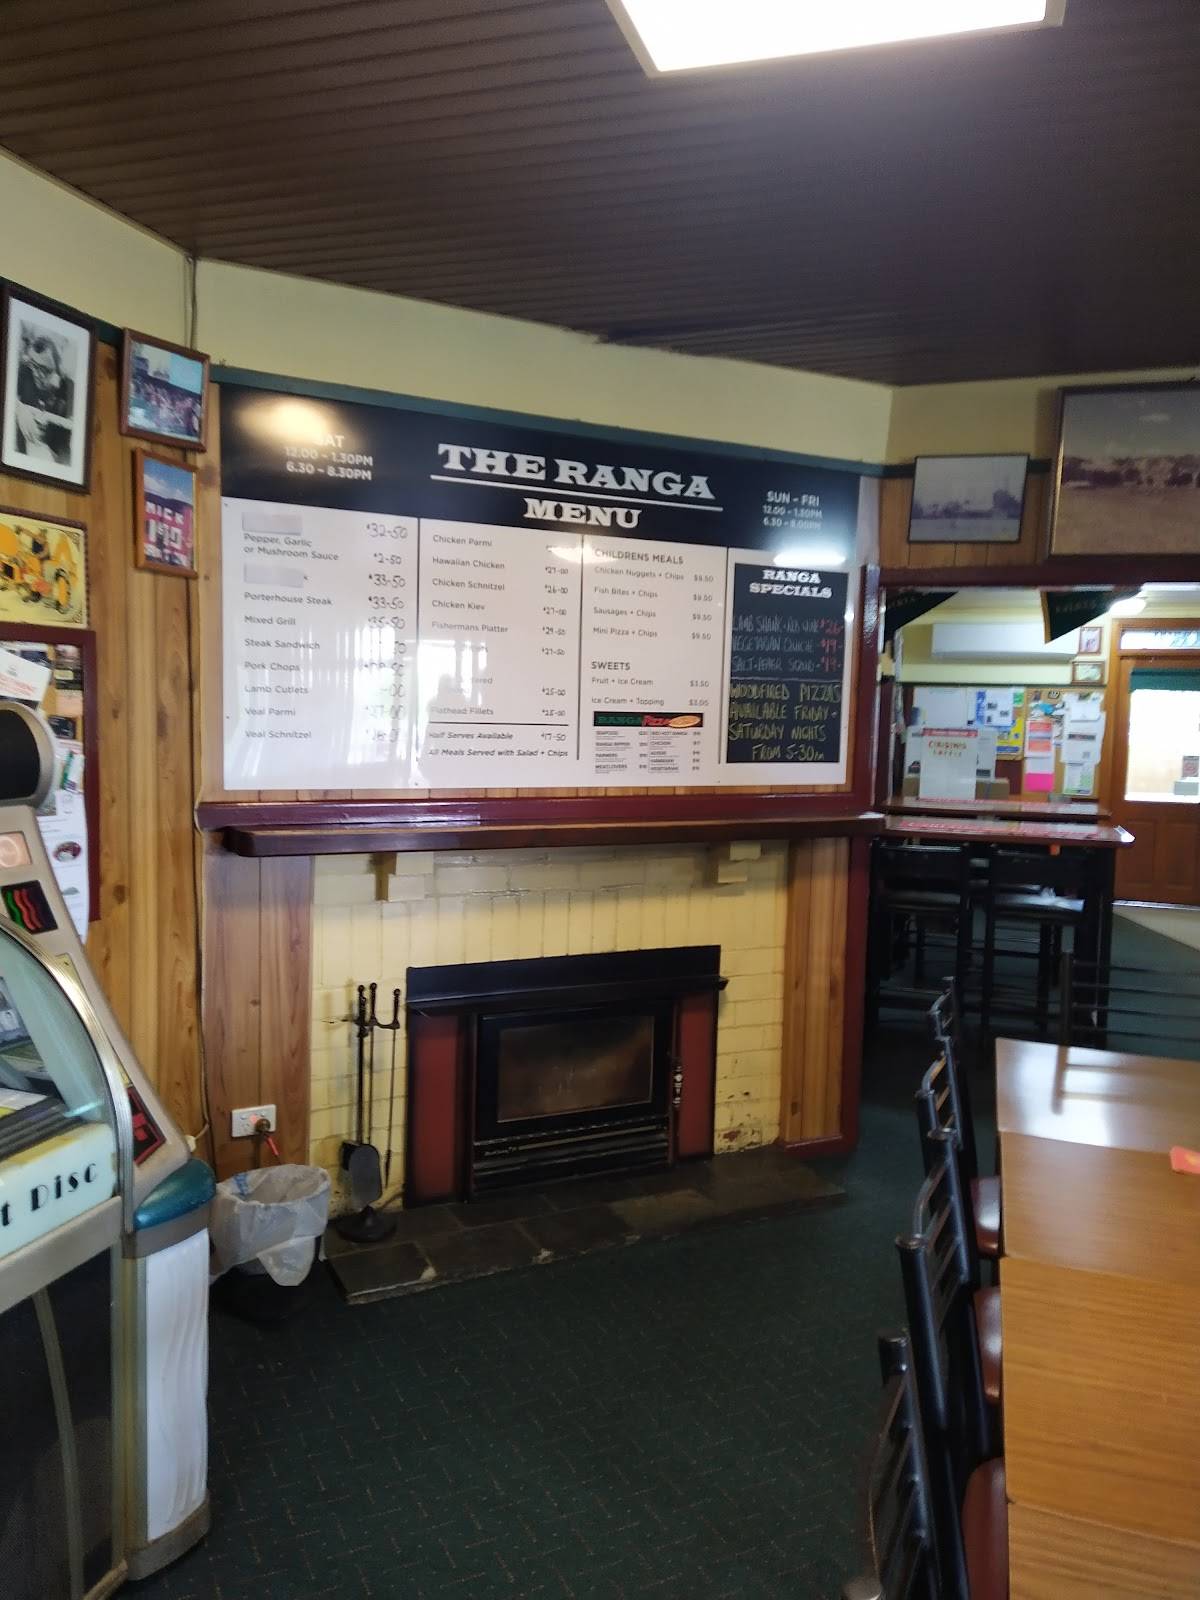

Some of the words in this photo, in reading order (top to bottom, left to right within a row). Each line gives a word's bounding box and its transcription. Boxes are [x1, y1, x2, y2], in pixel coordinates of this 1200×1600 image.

[332, 452, 373, 466] 1.30PM
[286, 461, 315, 475] 6.30
[327, 466, 372, 481] 8.30PM
[438, 443, 546, 481] THE
[554, 459, 716, 500] RANGA
[767, 490, 790, 504] SUN
[801, 494, 820, 506] FRI
[523, 497, 642, 529] MENU
[284, 537, 312, 547] Garlic
[432, 535, 466, 545] Chicken
[468, 538, 493, 547] Parmi
[257, 546, 308, 558] Mushroom
[311, 551, 339, 561] Sauce
[595, 549, 649, 561] CHILDRENS
[652, 555, 684, 564] MEALS
[432, 557, 471, 567] Hawaiian
[473, 560, 505, 569] Chicken
[594, 566, 624, 575] Chicken
[626, 569, 656, 578] Nuggets
[665, 572, 684, 580] Chips
[763, 569, 821, 584] RANGA
[432, 578, 466, 588] Chicken
[468, 581, 505, 591] Schnitzel
[749, 582, 832, 599] SPECIALS
[594, 586, 609, 594] Fish
[638, 589, 658, 598] Chips
[244, 592, 303, 604] Porterhouse
[306, 596, 333, 605] Steak
[432, 600, 465, 610] Chicken
[467, 602, 485, 610] Kiev
[593, 607, 628, 616] Sausages
[636, 609, 656, 618] Chips
[244, 615, 273, 624] Mixed
[276, 617, 296, 625] Grill
[432, 621, 479, 632] Fishermans
[481, 623, 508, 633] Platter
[593, 627, 608, 635] Mini
[610, 627, 629, 636] Pizza
[638, 629, 658, 638] Chips
[244, 639, 272, 648] Steak
[274, 640, 320, 650] Sandwich
[244, 661, 266, 670] Pork
[270, 662, 300, 672] Chops
[591, 661, 631, 671] SWEETS
[592, 677, 609, 685] Fruit
[630, 678, 654, 686] Cream
[244, 685, 272, 694] Lamb
[274, 685, 309, 695] Cutlets
[800, 684, 840, 703] PIZZAS
[636, 697, 664, 706] Topping
[244, 708, 266, 716] Veal
[268, 708, 296, 717] Parmi
[794, 704, 828, 721] FRIDAY
[244, 730, 266, 738] Veal
[268, 730, 312, 739] Schnitzel
[448, 732, 474, 740] Serves
[477, 732, 513, 740] Available
[729, 722, 784, 740] SATURDAY
[441, 749, 464, 757] Meals
[467, 749, 495, 757] Served
[752, 743, 781, 760] FROM
[31, 1163, 97, 1211] Disc
